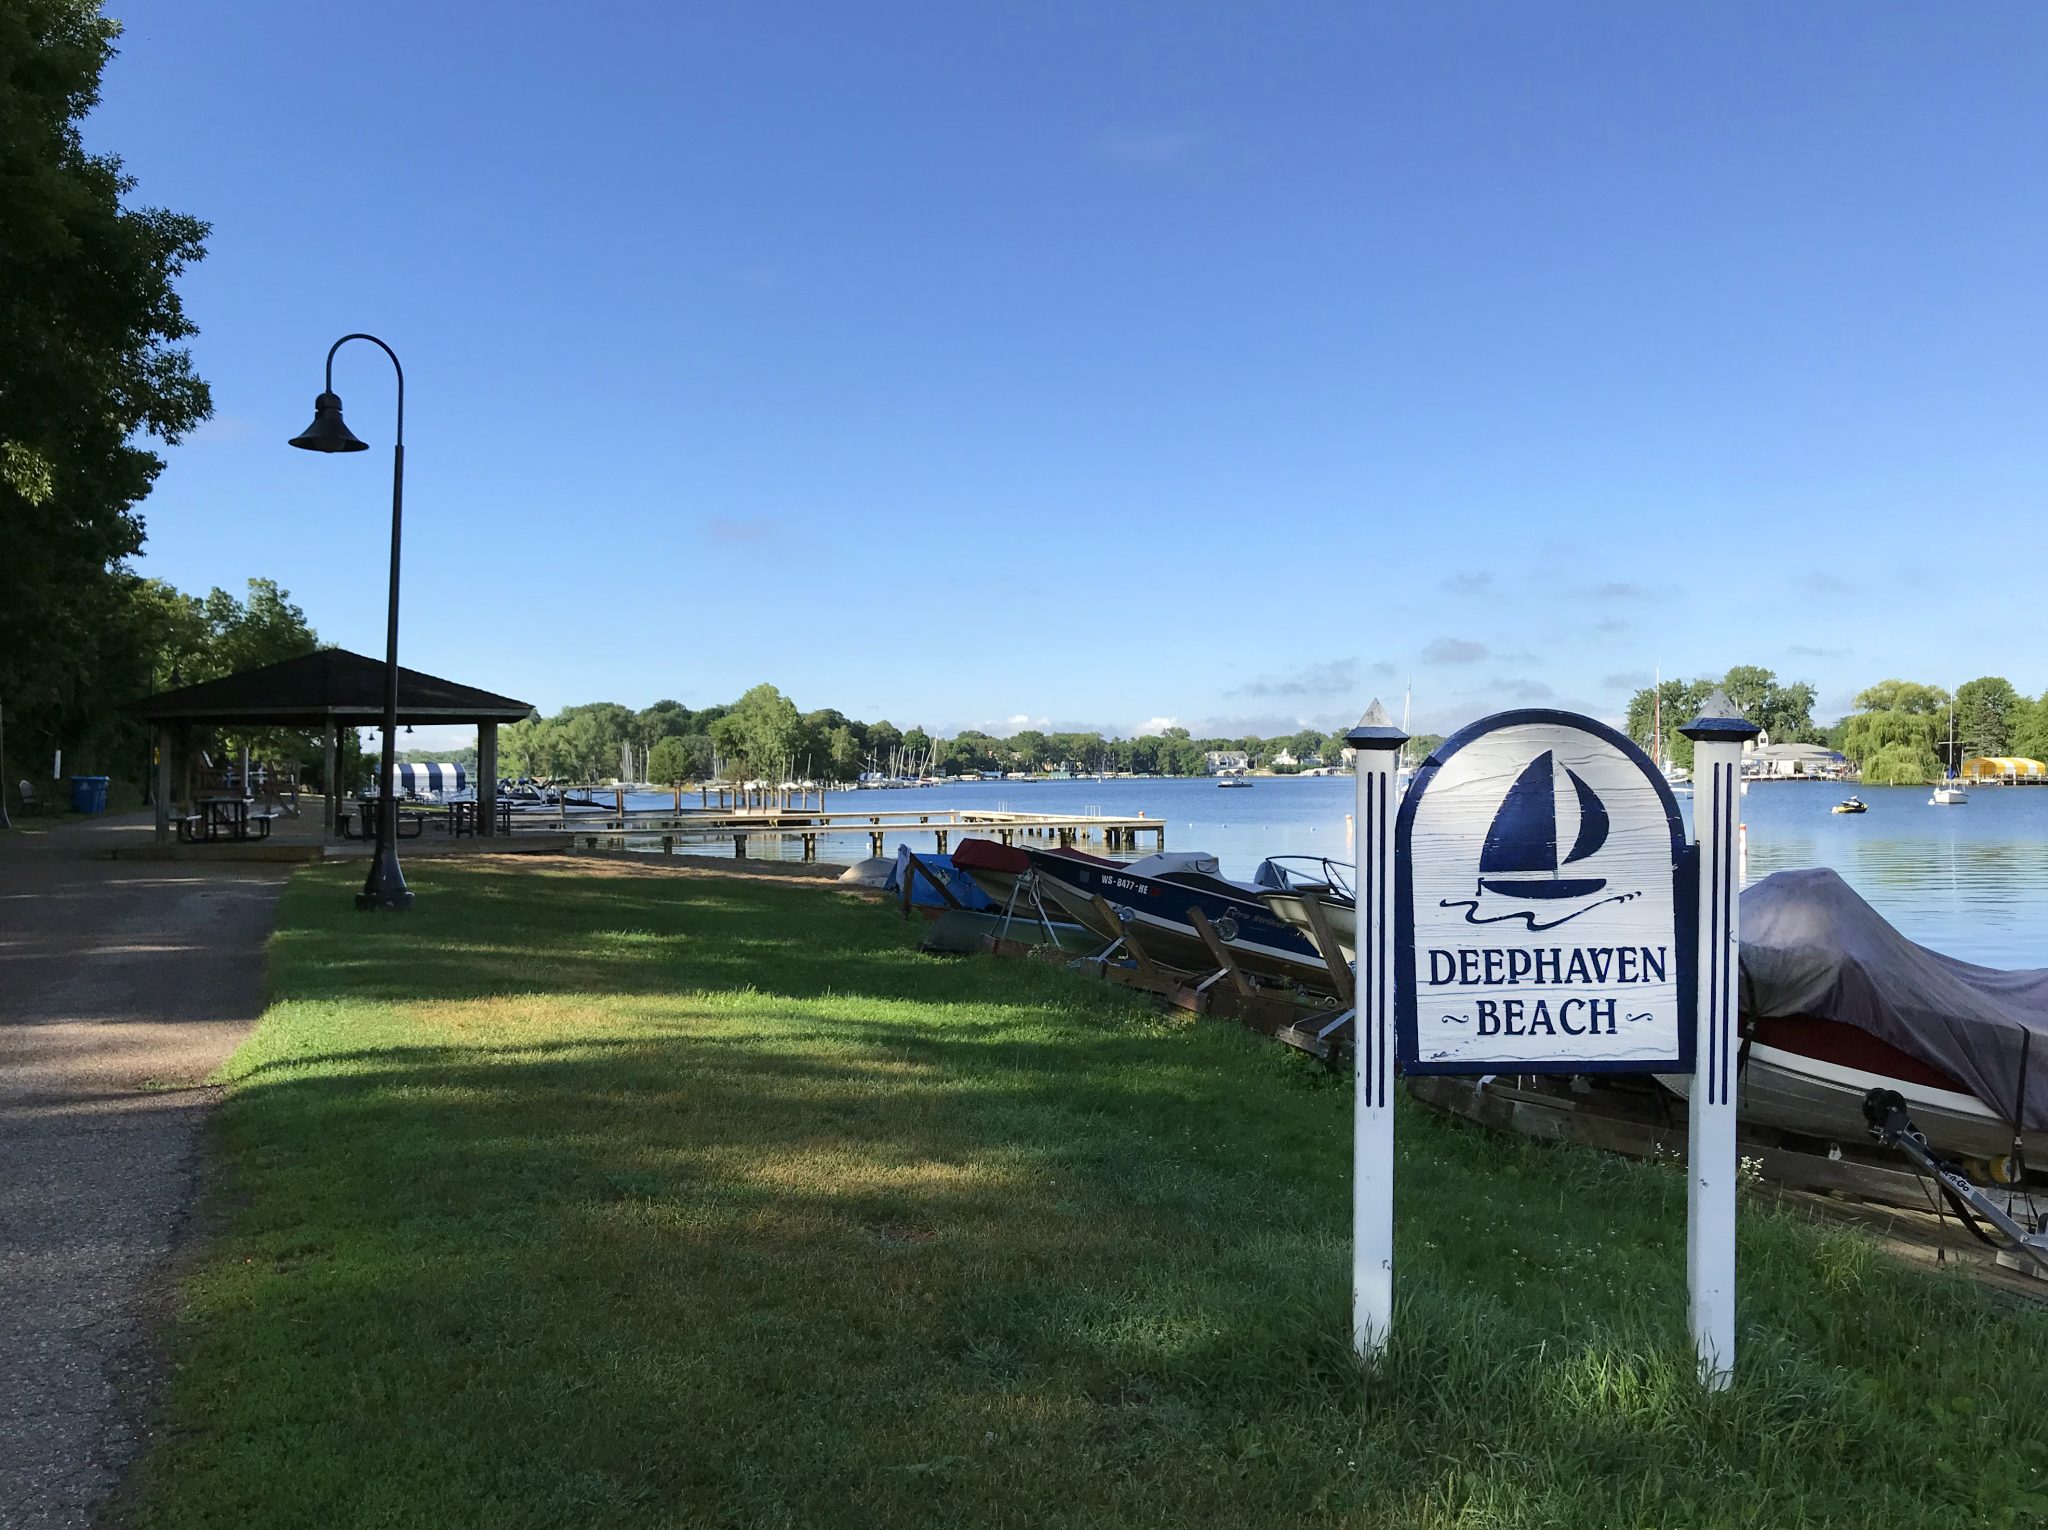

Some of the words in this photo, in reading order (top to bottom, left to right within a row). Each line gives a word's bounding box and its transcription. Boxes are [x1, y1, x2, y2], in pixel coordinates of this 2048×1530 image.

[1101, 874, 1149, 895] WS-8477-HE
[1428, 947, 1667, 986] DEEPHAVEN
[1476, 999, 1618, 1036] BEACH
